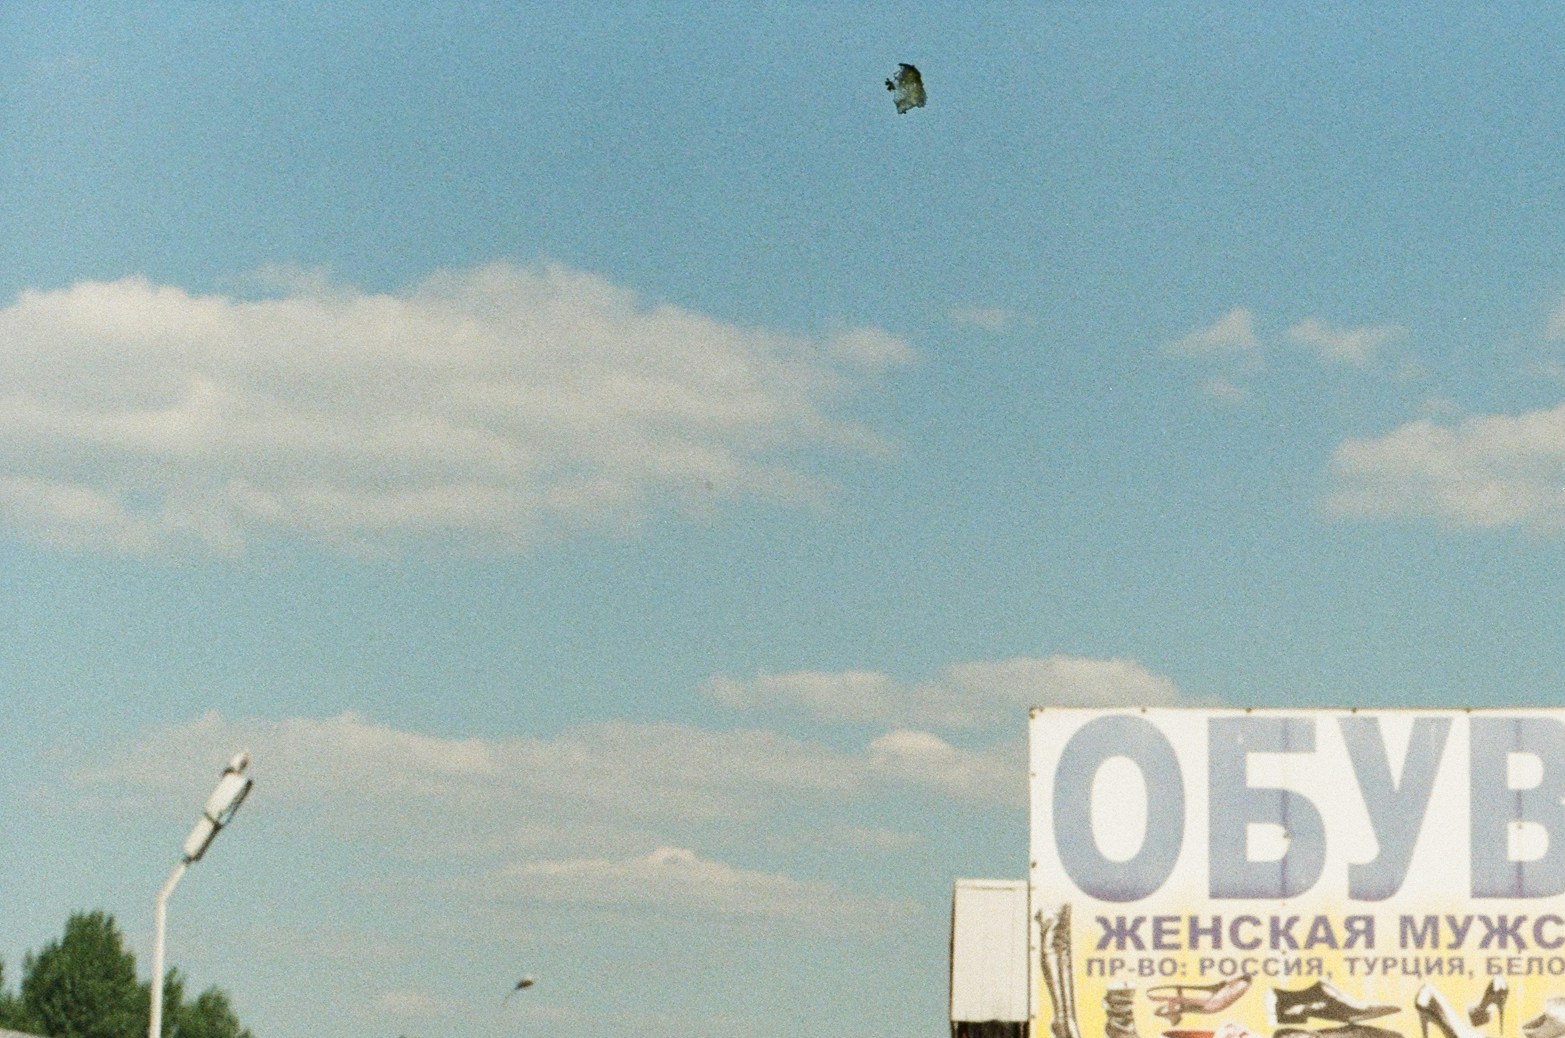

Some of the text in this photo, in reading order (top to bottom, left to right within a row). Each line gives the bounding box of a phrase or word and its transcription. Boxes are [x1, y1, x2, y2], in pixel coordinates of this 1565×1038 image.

[1095, 915, 1375, 951] ЖЕНСКАЯ
[1086, 957, 1188, 978] ПР-ВО:
[1199, 956, 1333, 981] РОССИЯ,
[1344, 956, 1475, 981] ТУРЦИЯ,
